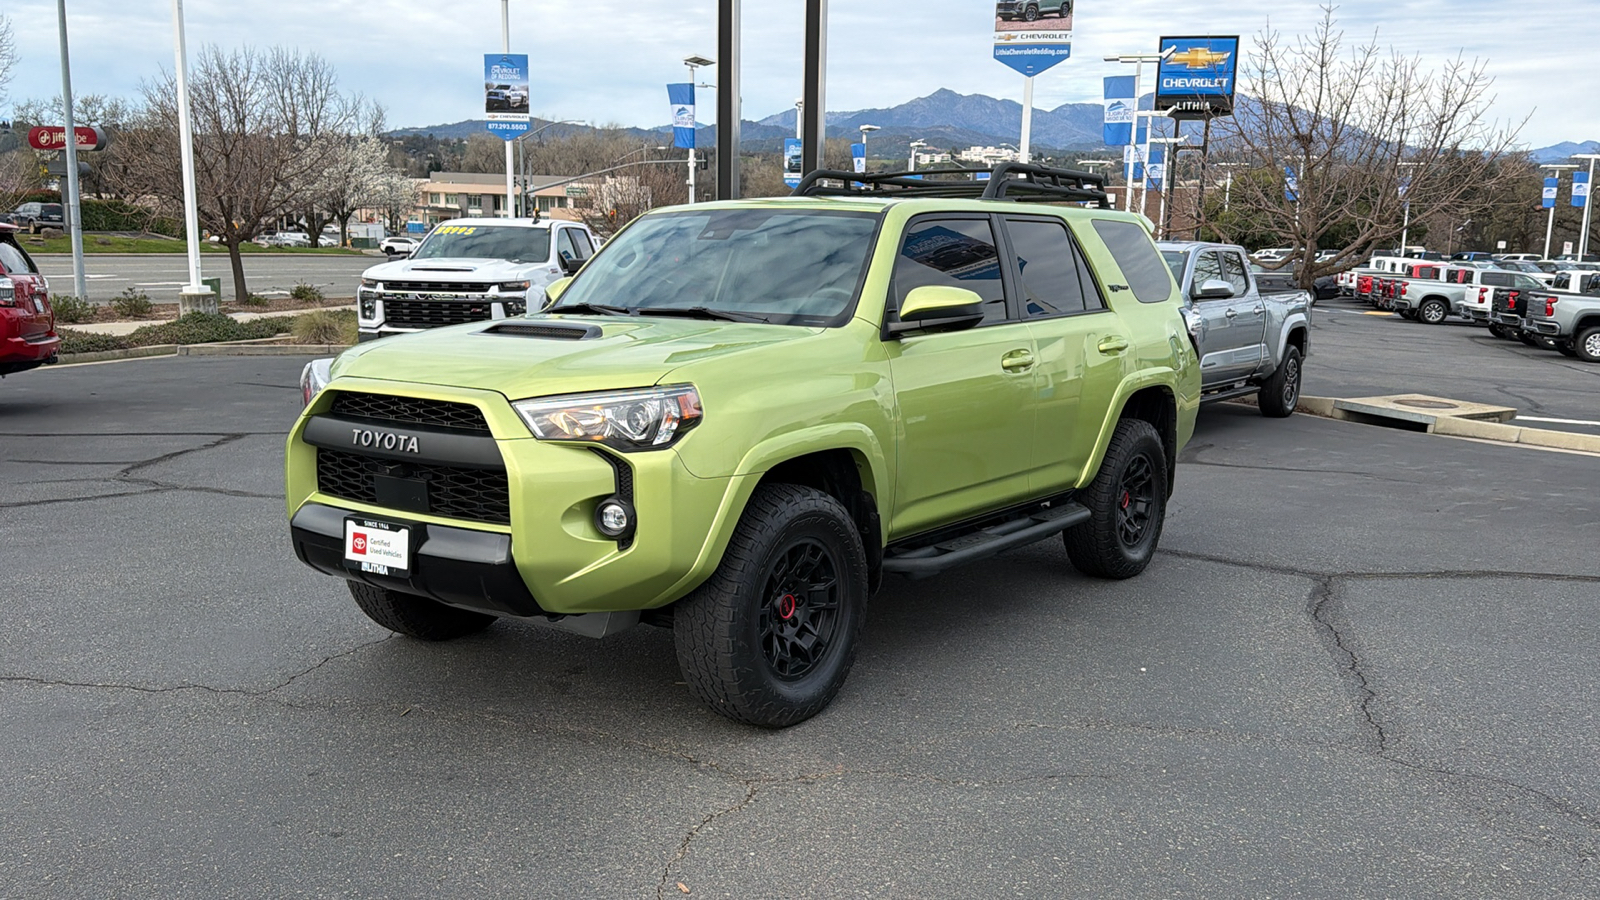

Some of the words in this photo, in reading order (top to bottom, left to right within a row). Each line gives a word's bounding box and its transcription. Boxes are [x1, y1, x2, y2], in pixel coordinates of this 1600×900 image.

[995, 47, 1068, 56] LithiaChevroletRedding.com
[1162, 77, 1229, 88] CHEVROLET
[1176, 101, 1211, 110] LITHIA
[351, 428, 419, 453] TOYOTA
[364, 520, 378, 528] SINCE
[378, 522, 389, 530] 1946
[369, 537, 391, 548] Certified
[369, 546, 382, 555] Used
[382, 549, 403, 559] Vehicles
